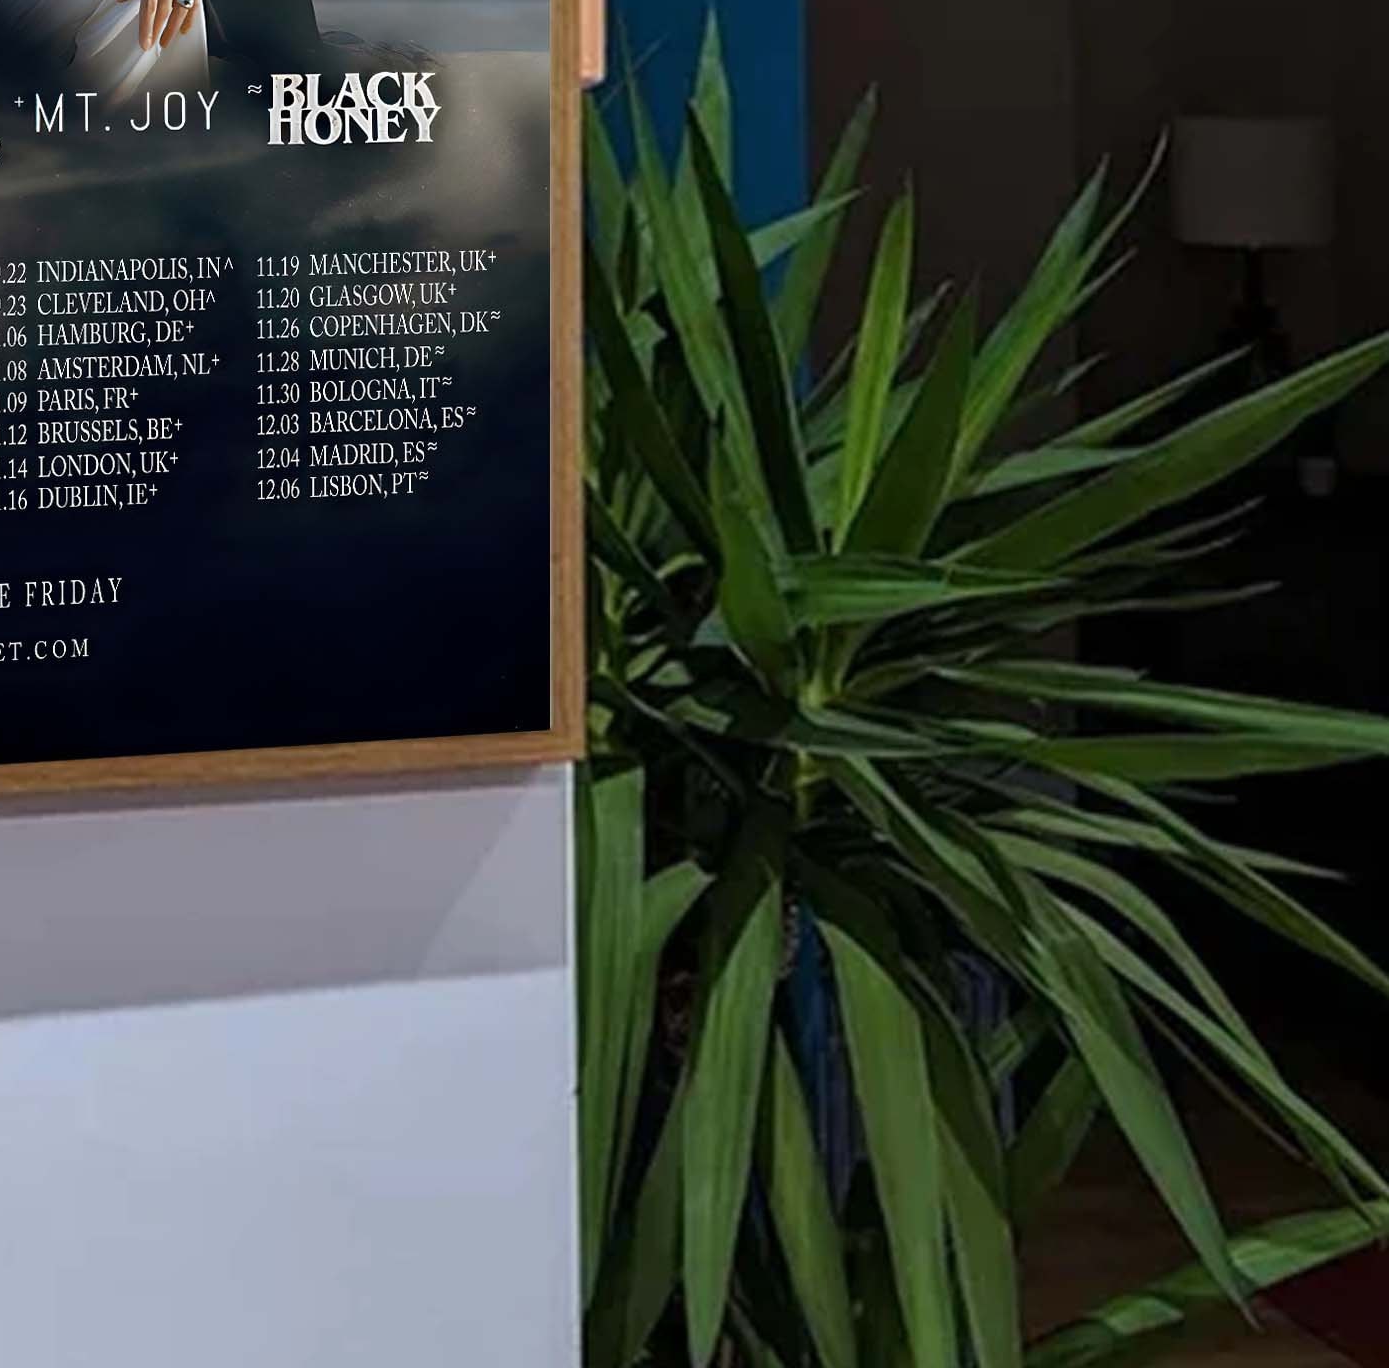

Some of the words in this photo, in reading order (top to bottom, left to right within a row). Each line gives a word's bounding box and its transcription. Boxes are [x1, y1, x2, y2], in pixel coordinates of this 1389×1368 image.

[269, 71, 436, 110] BLACK
[35, 92, 111, 133] MT.
[130, 90, 220, 131] JOY
[267, 105, 442, 145] HONEY
[36, 257, 193, 284] INDIANAPOLIS,
[257, 255, 300, 277] 11.19
[308, 250, 456, 276] MANCHESTER,
[37, 290, 169, 317] CLEVELAND,
[257, 287, 300, 309] 11.20
[309, 283, 416, 309] GLASGOW,
[37, 320, 151, 348] HAMBURG,
[257, 317, 300, 340] 11.26
[309, 312, 457, 338] COPENHAGEN,
[36, 353, 178, 380] AMSTERDAM,
[257, 350, 300, 373] 11.28
[308, 346, 400, 373] MUNICH,
[37, 387, 100, 415] PARIS,
[257, 382, 300, 405] 11.30
[309, 377, 416, 404] BOLOGNA,
[37, 418, 143, 445] BRUSSELS,
[257, 413, 300, 436] 12.03
[309, 407, 438, 434] BARCELONA,
[38, 452, 137, 479] LONDON,
[257, 447, 300, 470] 12.04
[309, 442, 399, 468] MADRID,
[37, 484, 124, 510] DUBLIN,
[257, 478, 301, 500] 12.06
[309, 473, 388, 499] LISBON,
[24, 577, 123, 607] FRIDAY
